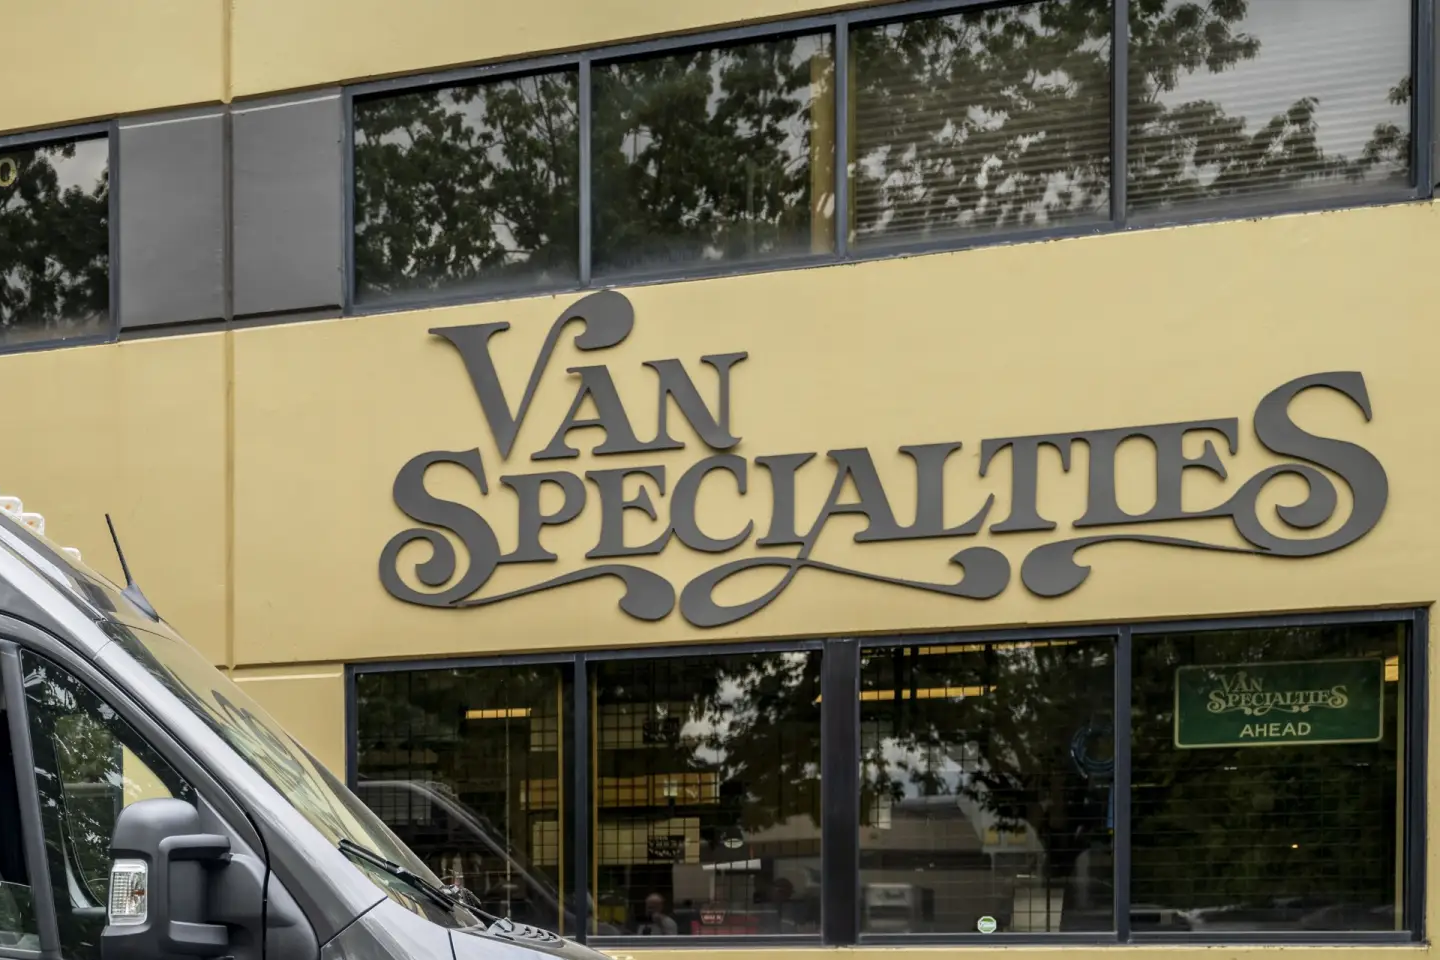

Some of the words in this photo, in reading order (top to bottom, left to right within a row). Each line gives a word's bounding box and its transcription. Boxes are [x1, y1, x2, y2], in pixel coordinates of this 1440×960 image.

[428, 289, 749, 463] VAN
[378, 370, 1389, 628] SPECIALTIES
[1219, 671, 1263, 693] VAN
[1206, 685, 1349, 716] SPECIALTIES
[1240, 722, 1312, 738] AHEAD
